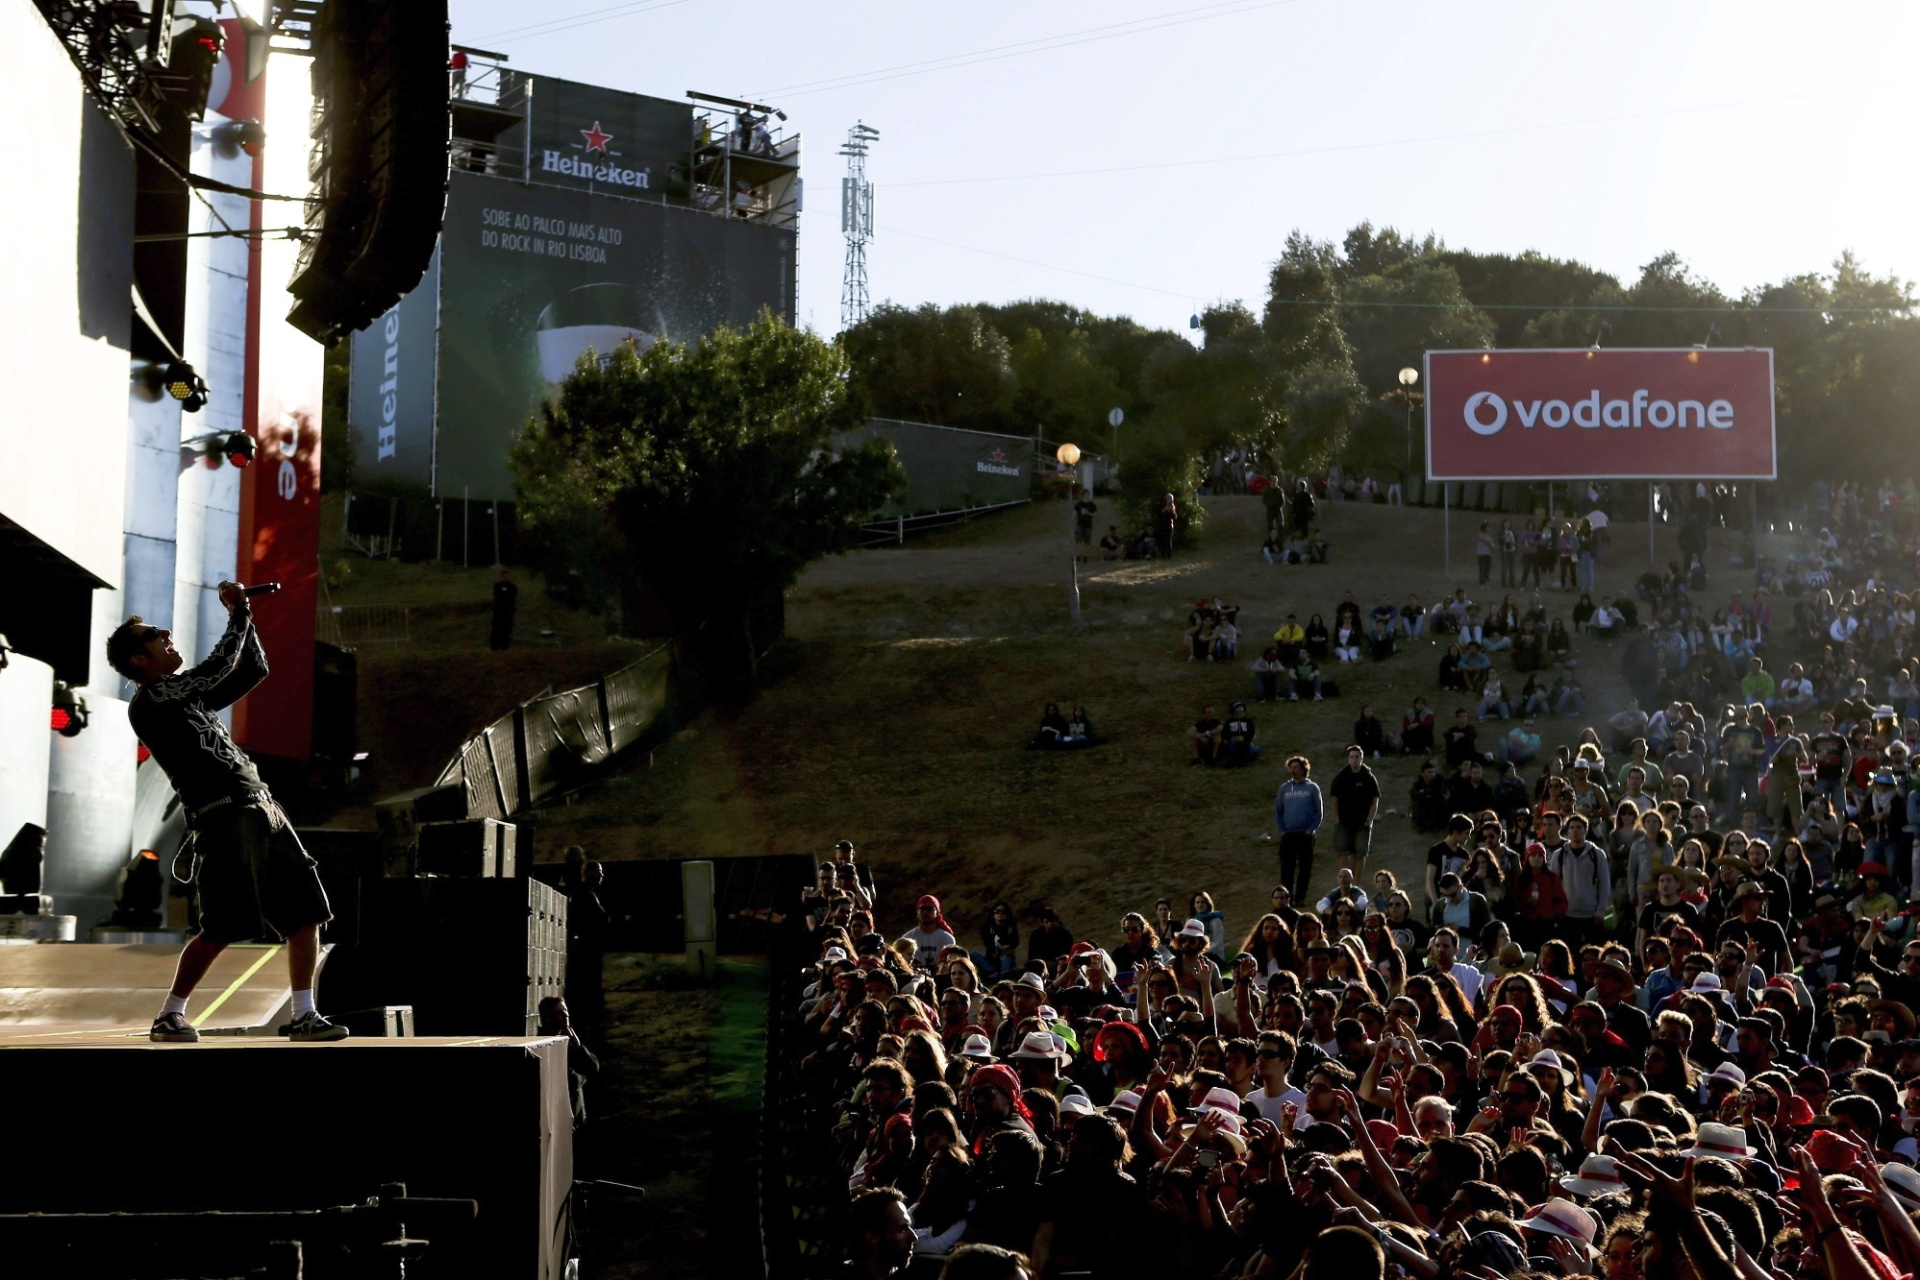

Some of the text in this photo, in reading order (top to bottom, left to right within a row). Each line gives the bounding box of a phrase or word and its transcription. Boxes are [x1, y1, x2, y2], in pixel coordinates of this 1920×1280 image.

[542, 149, 650, 188] Heineken
[482, 207, 622, 245] SOBE AO PALCO MAIS ALTO
[482, 230, 607, 264] DO ROCK IN RIO LISBOA
[377, 301, 401, 463] Heine
[1512, 389, 1735, 428] vodafone
[977, 462, 1019, 476] Heineken
